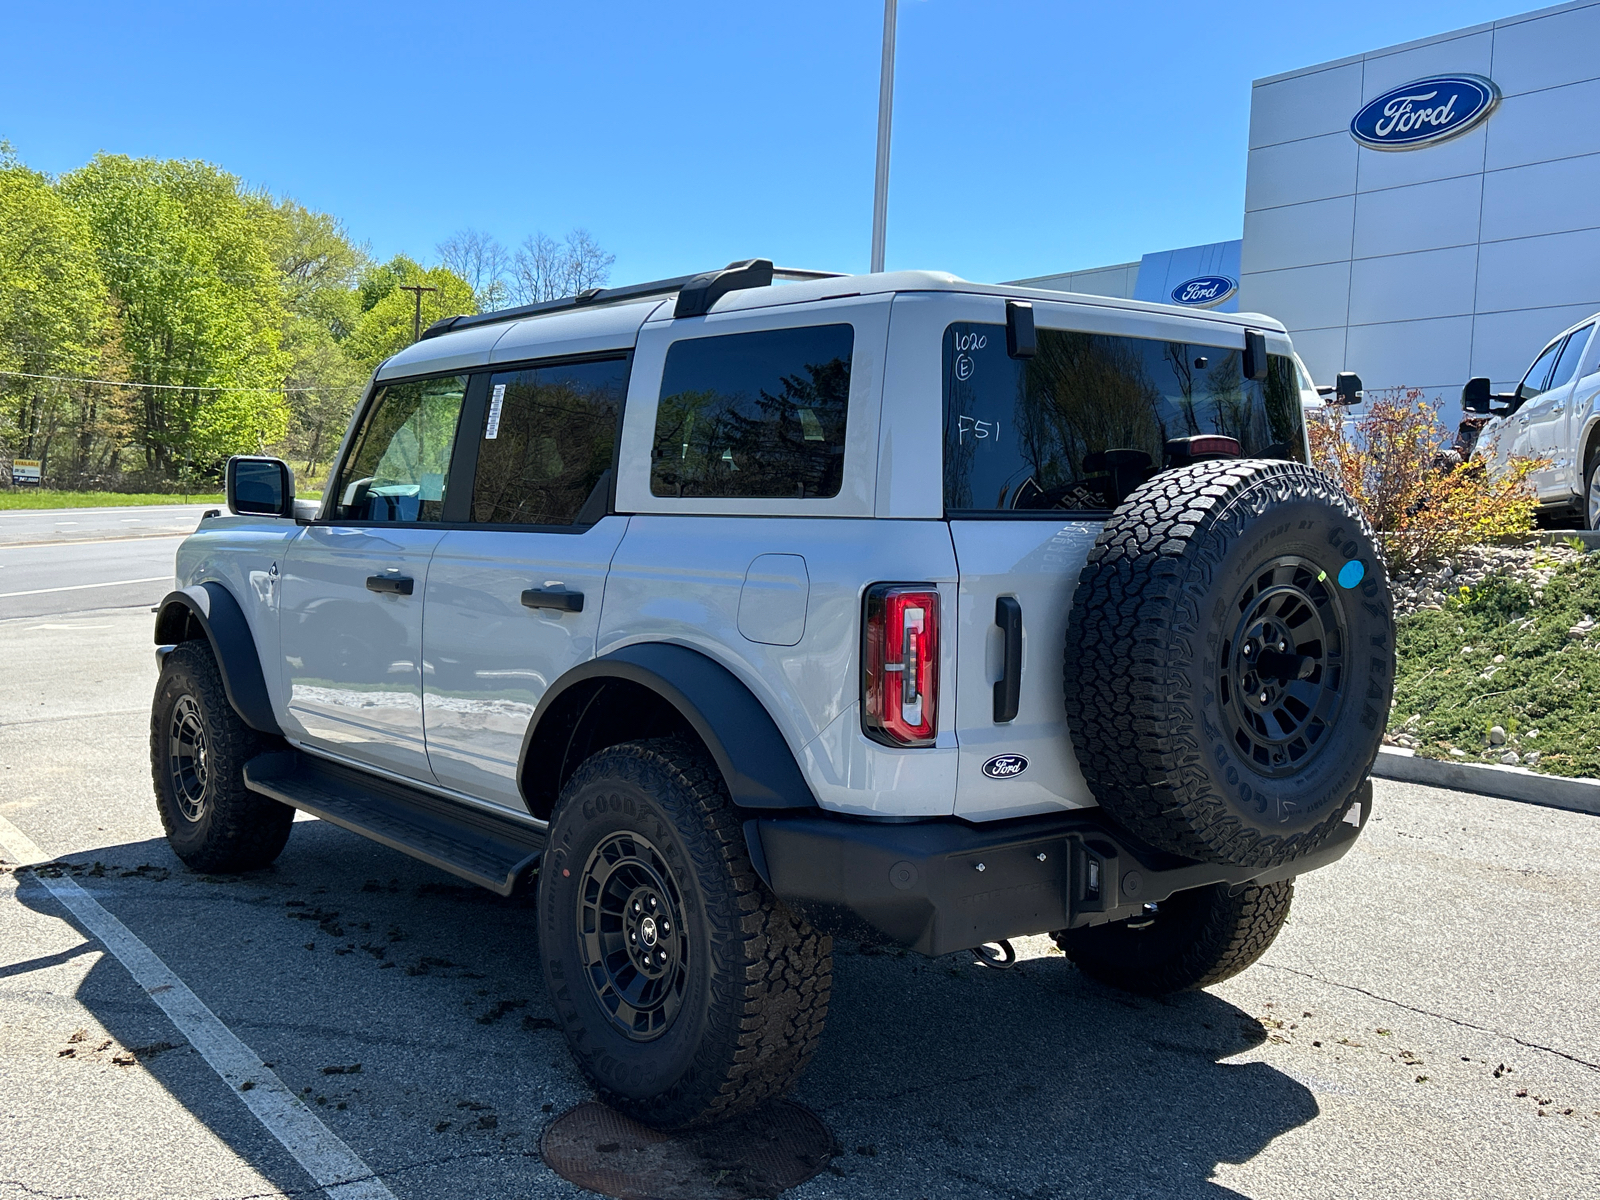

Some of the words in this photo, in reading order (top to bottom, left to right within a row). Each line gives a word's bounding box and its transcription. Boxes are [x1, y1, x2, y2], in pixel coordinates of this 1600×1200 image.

[1375, 90, 1458, 137] Ford
[1182, 281, 1219, 301] Ford
[956, 332, 987, 351] 1020
[958, 357, 972, 378] E
[957, 415, 1001, 446] F51
[992, 758, 1022, 775] Ford
